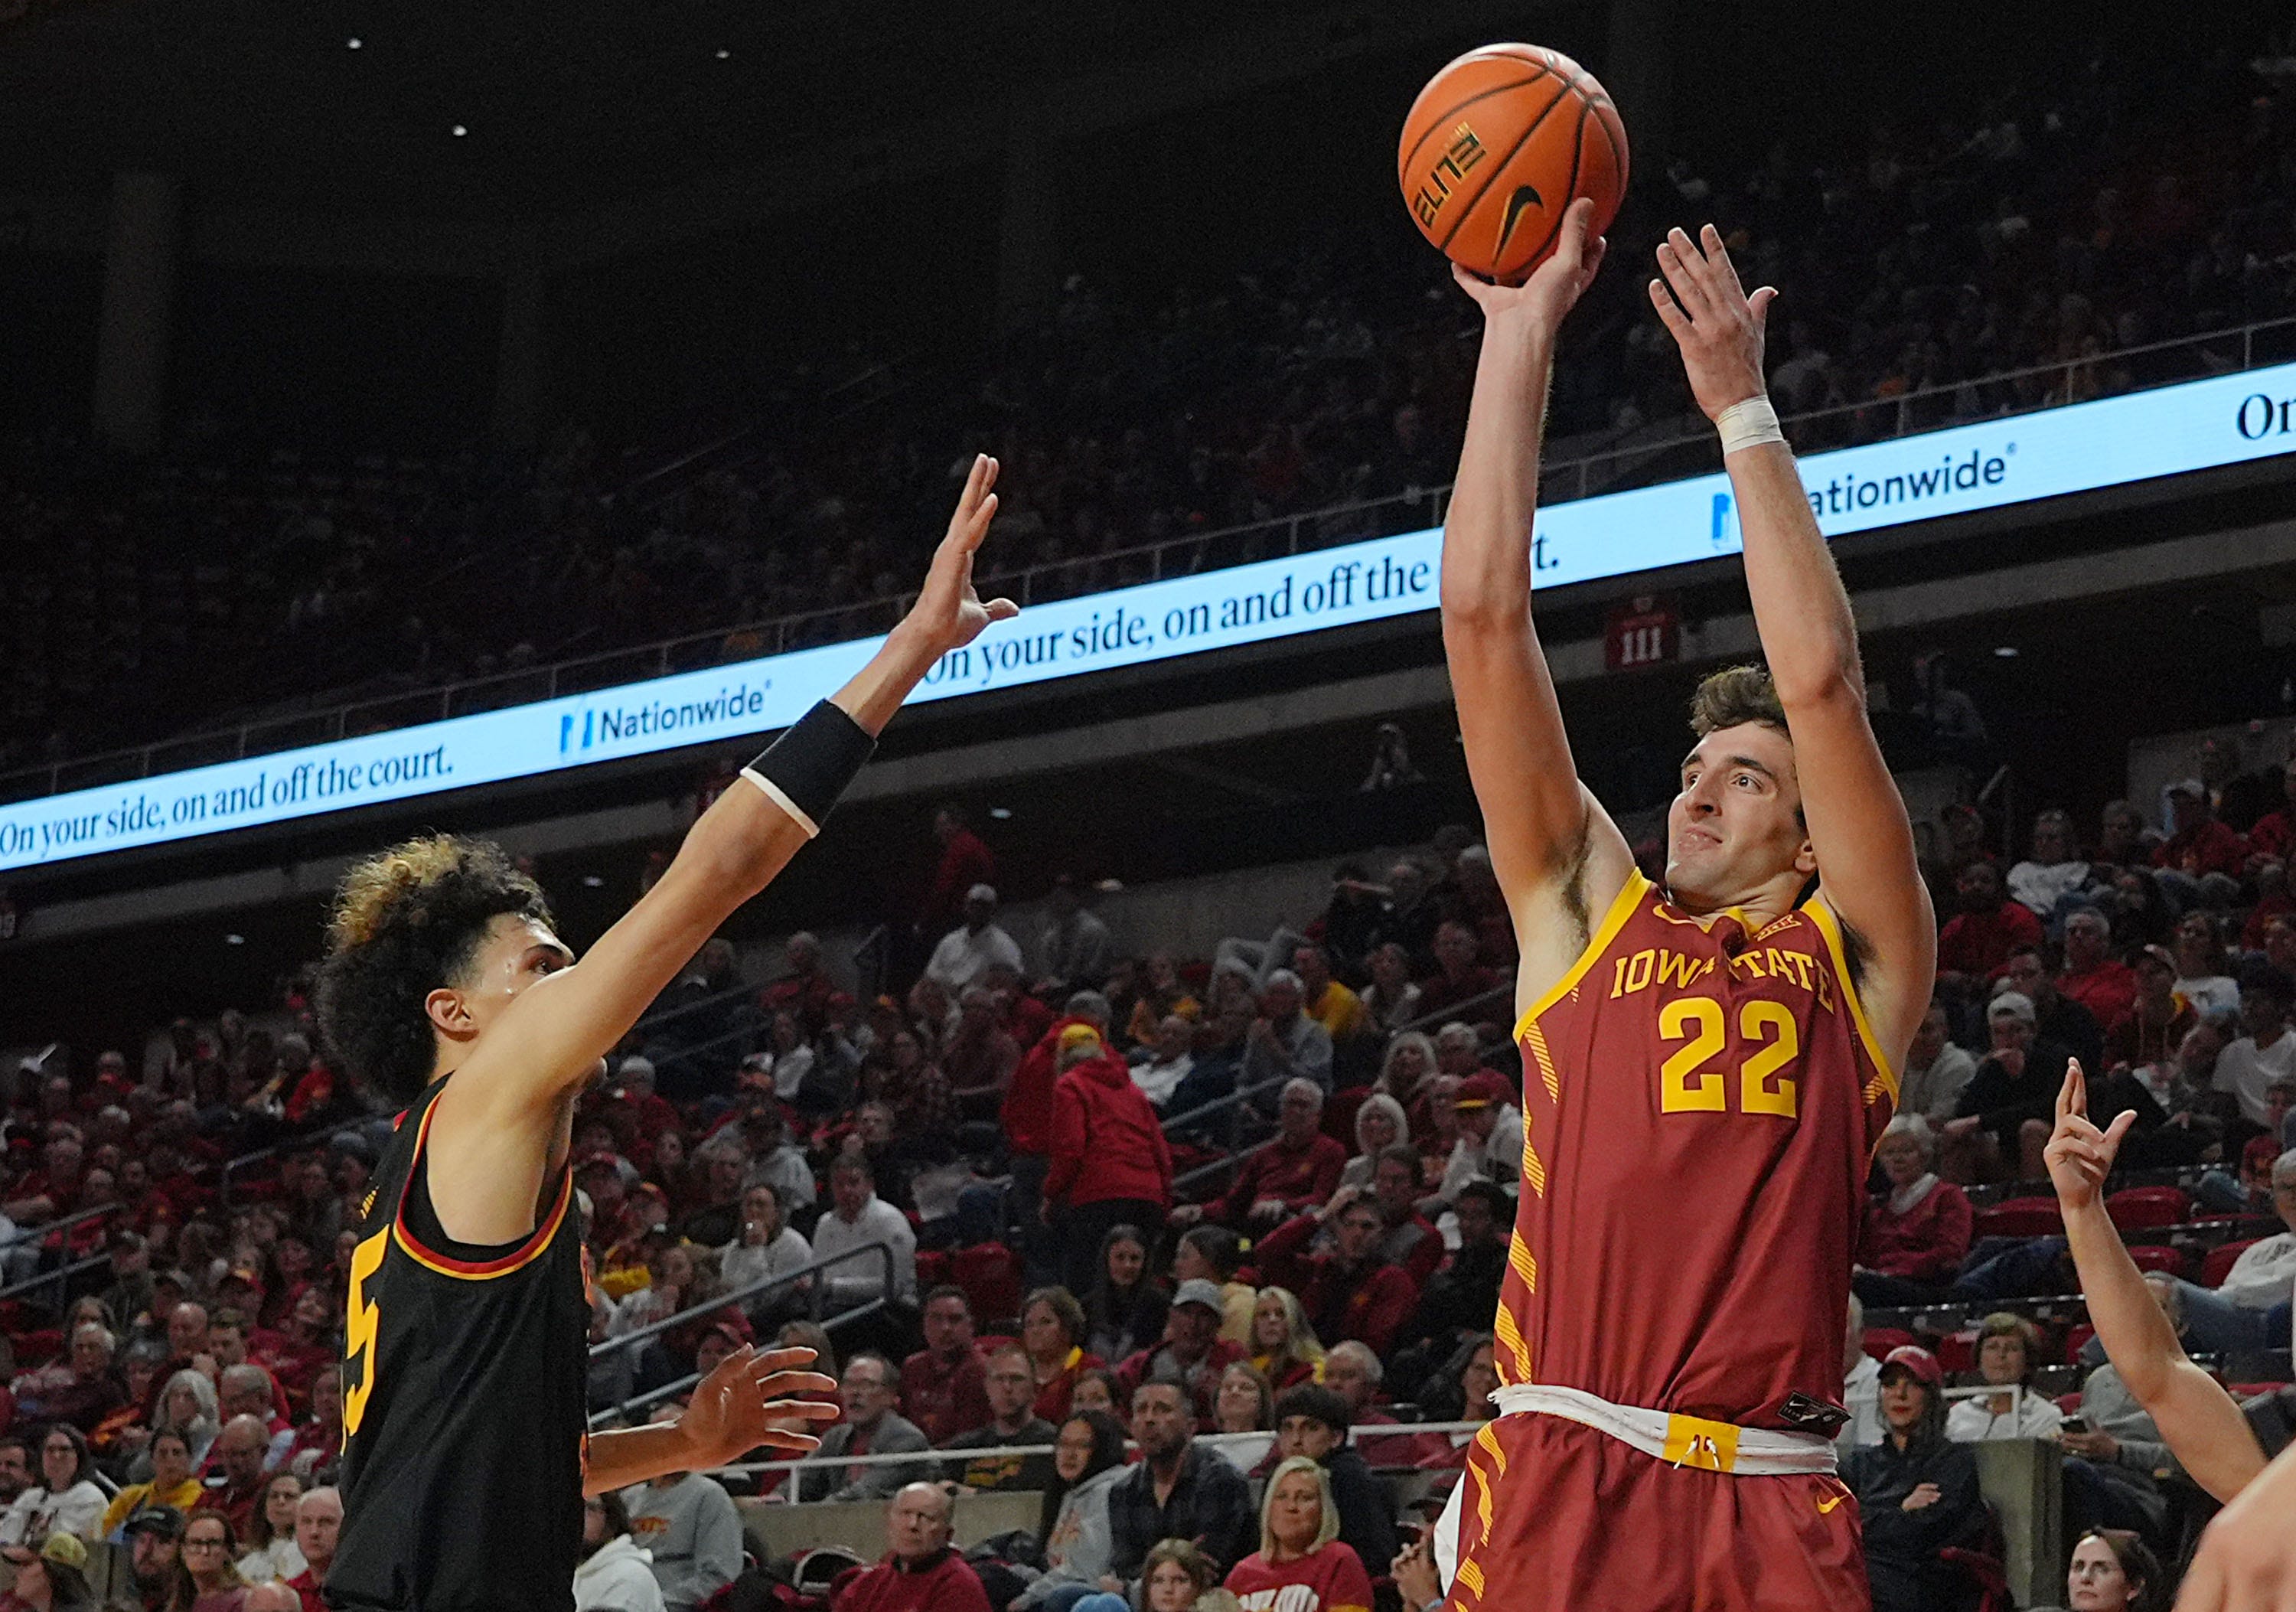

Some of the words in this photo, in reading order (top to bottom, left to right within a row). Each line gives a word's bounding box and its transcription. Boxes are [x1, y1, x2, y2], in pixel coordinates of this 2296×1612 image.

[1413, 132, 1487, 229] ELITE
[1807, 449, 2005, 516] ationwide
[980, 632, 1065, 685] your
[1071, 609, 1153, 660] side,
[1164, 607, 1211, 641] on
[1220, 576, 1293, 622] and
[1303, 562, 1362, 612] off
[1367, 556, 1430, 601] the
[0, 821, 34, 857] On
[41, 814, 102, 860] your
[106, 794, 166, 837] side,
[172, 791, 207, 825] on
[213, 772, 265, 816] and
[272, 762, 315, 804] off
[316, 759, 362, 798] the
[367, 744, 454, 789] court.
[1728, 948, 1834, 1014] TATE
[1658, 997, 1799, 1118] 22
